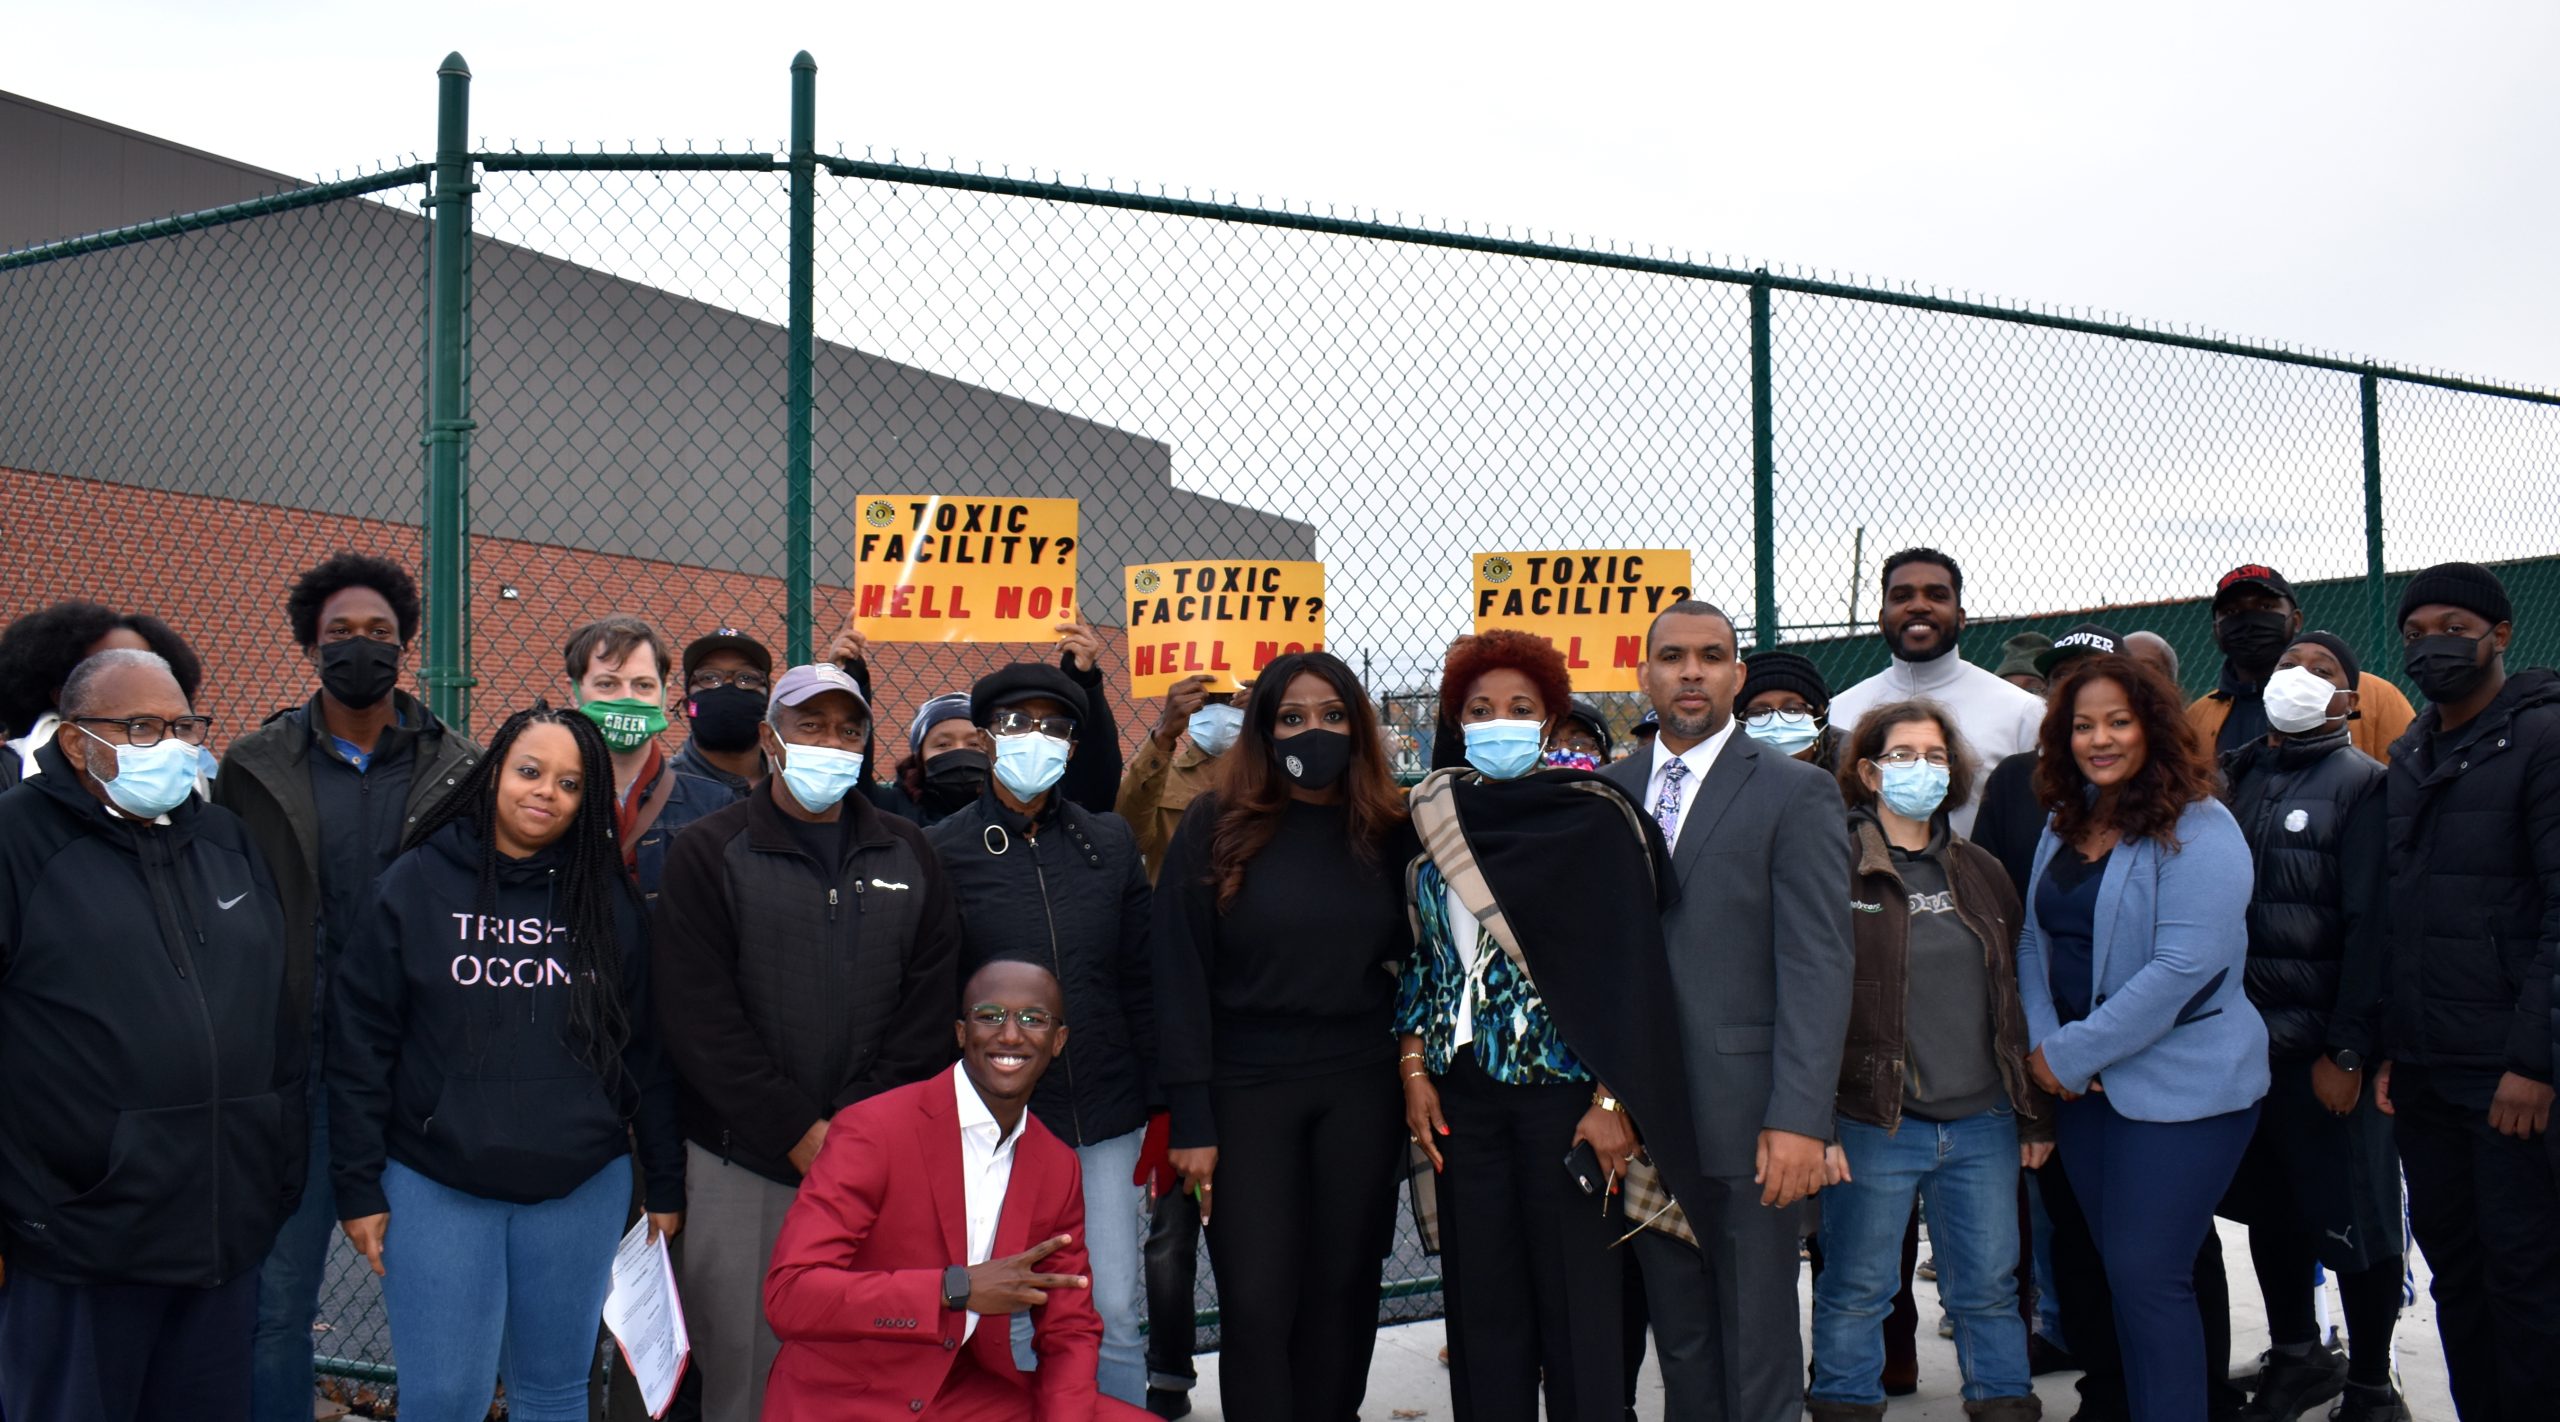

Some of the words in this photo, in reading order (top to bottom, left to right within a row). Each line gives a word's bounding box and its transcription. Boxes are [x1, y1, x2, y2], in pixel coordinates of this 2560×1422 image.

[910, 503, 1029, 533] TOXIC
[860, 534, 1075, 565] FACILITY?
[1173, 567, 1281, 593] TOXIC
[1527, 556, 1643, 585] TOXIC
[859, 584, 970, 619] HELL
[995, 586, 1073, 620] NO!
[1132, 595, 1323, 626] FACILITY?
[1478, 586, 1691, 617] FACILITY?
[2054, 632, 2114, 653] POWER
[1135, 641, 1230, 676] HELL
[604, 714, 646, 731] GREEN
[452, 913, 577, 945] TRISH
[451, 954, 596, 988] OCON
